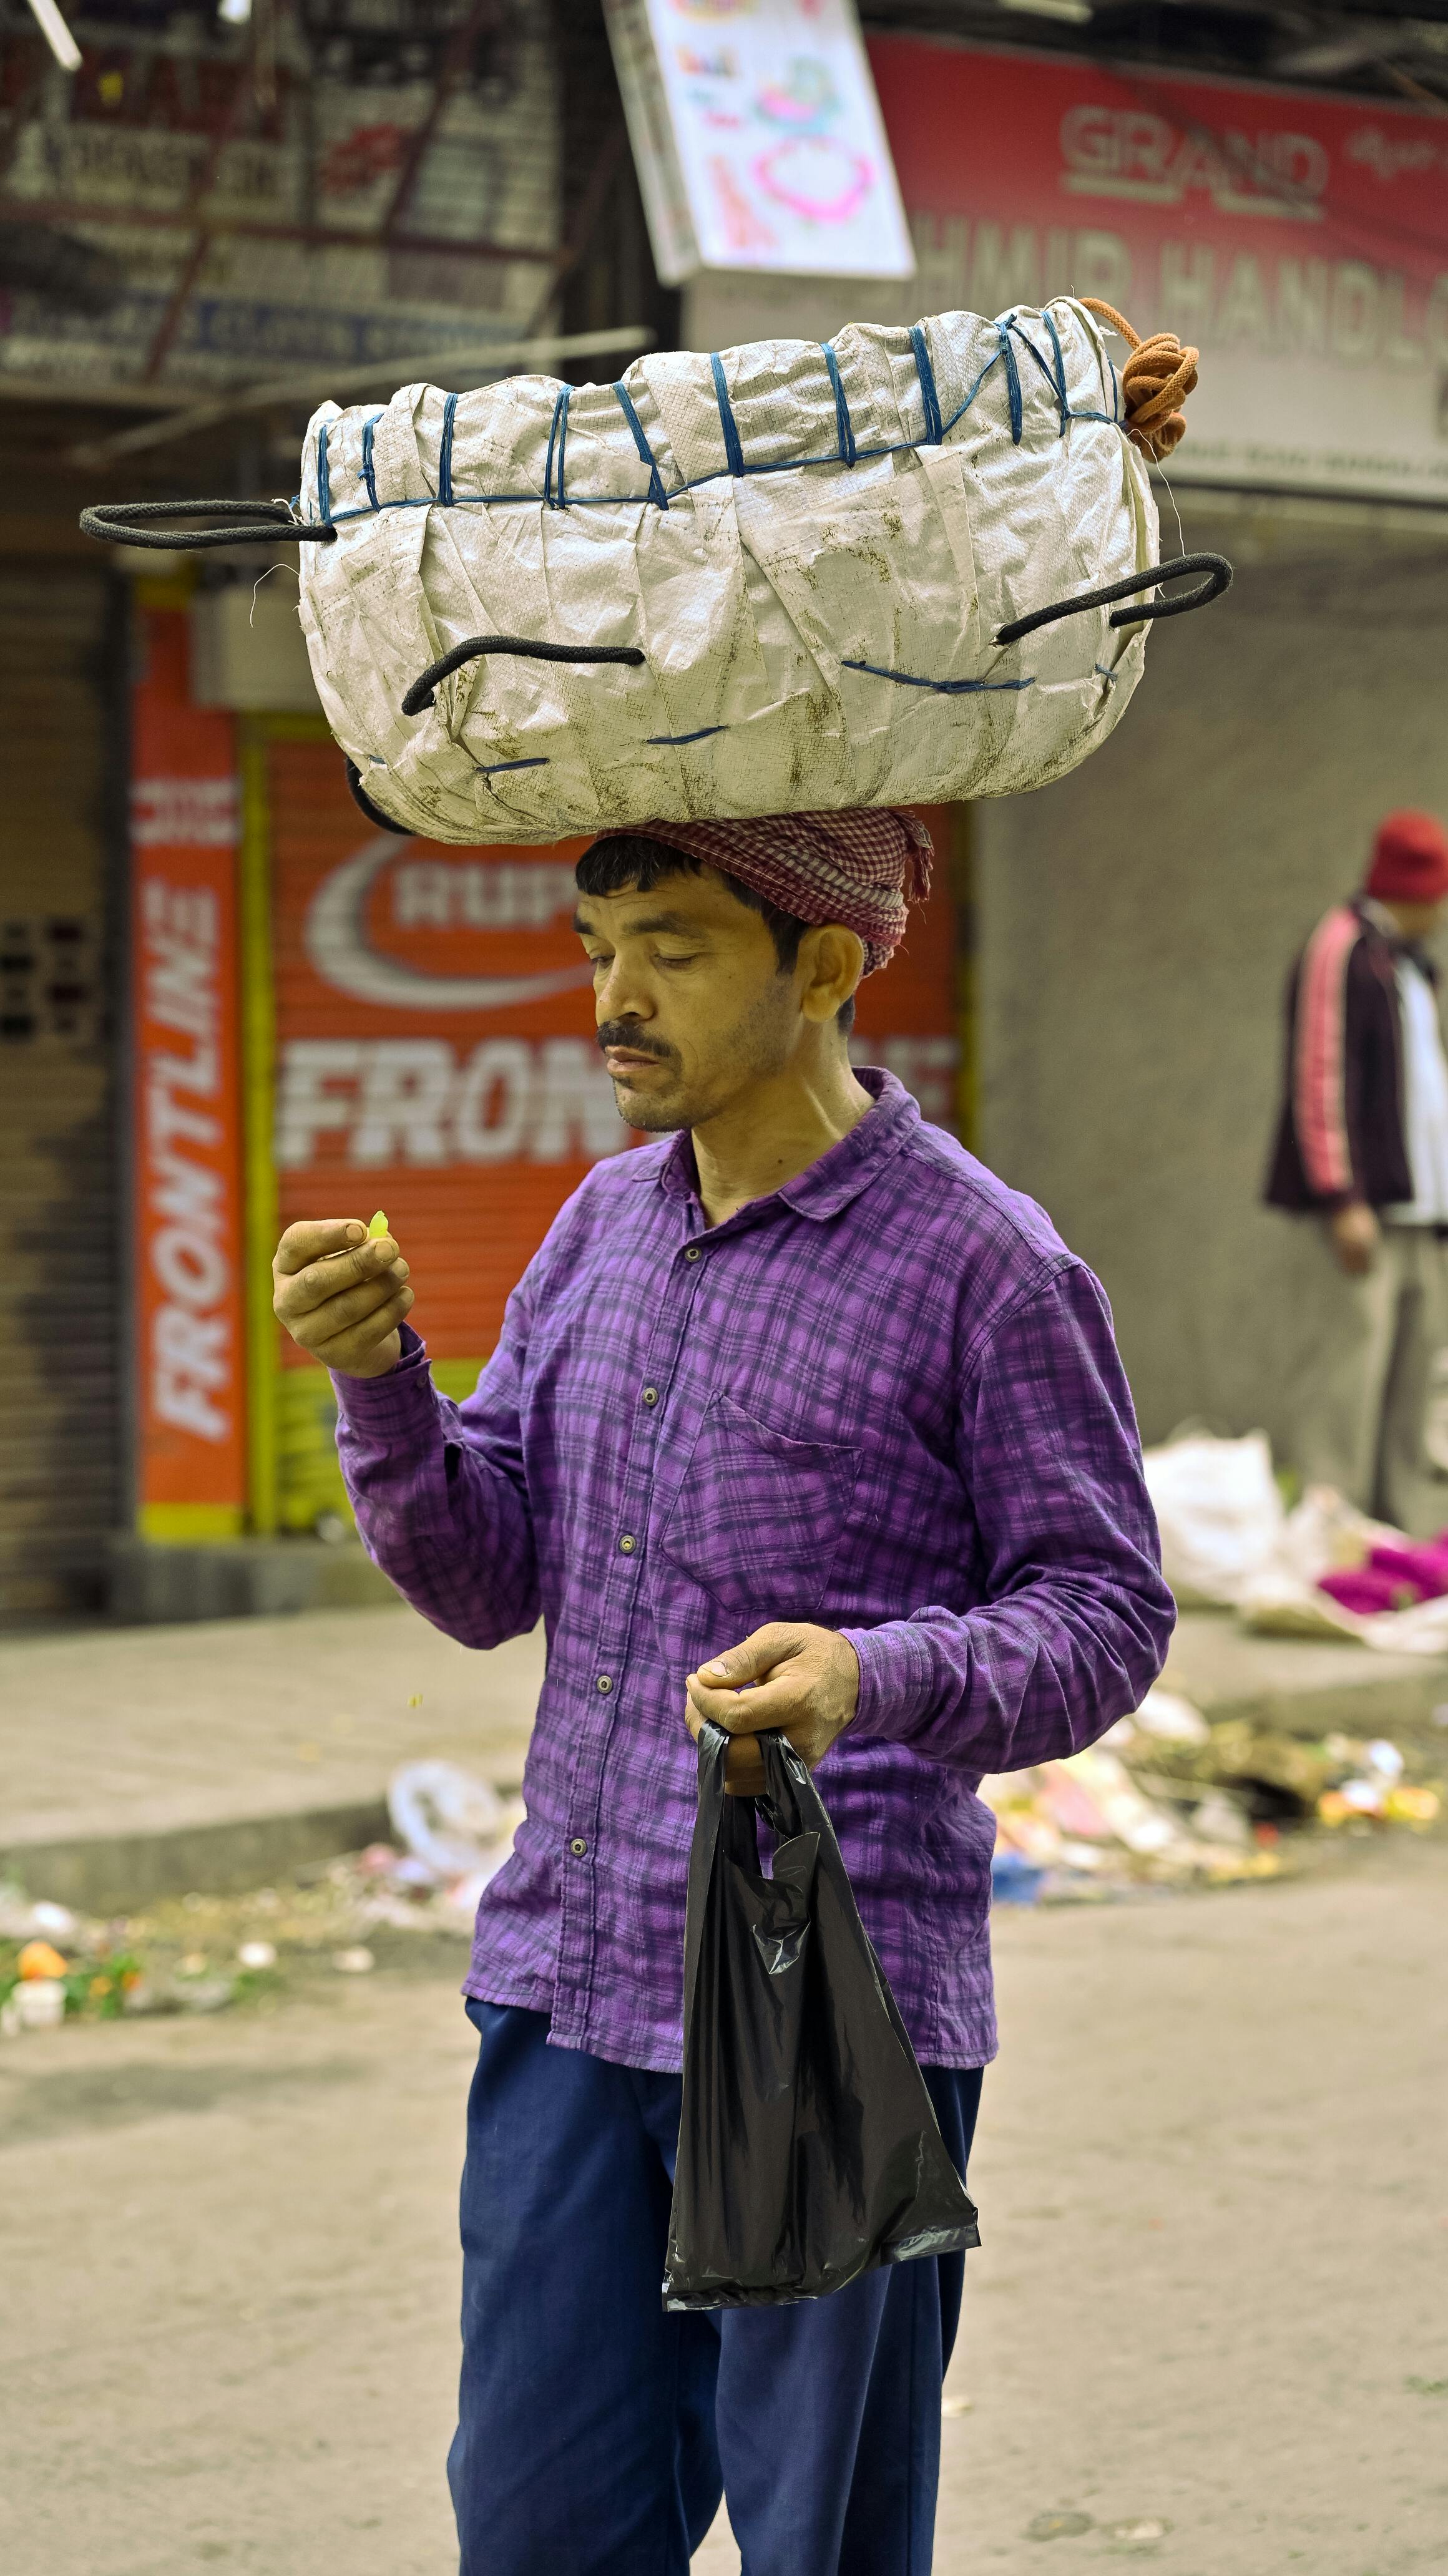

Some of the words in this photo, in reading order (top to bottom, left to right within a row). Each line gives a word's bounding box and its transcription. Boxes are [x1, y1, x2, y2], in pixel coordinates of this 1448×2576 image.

[1060, 104, 1331, 211] GRAND
[909, 211, 1133, 320] HMIR
[397, 860, 579, 930] RUP
[144, 875, 231, 1443] FRONTLINE
